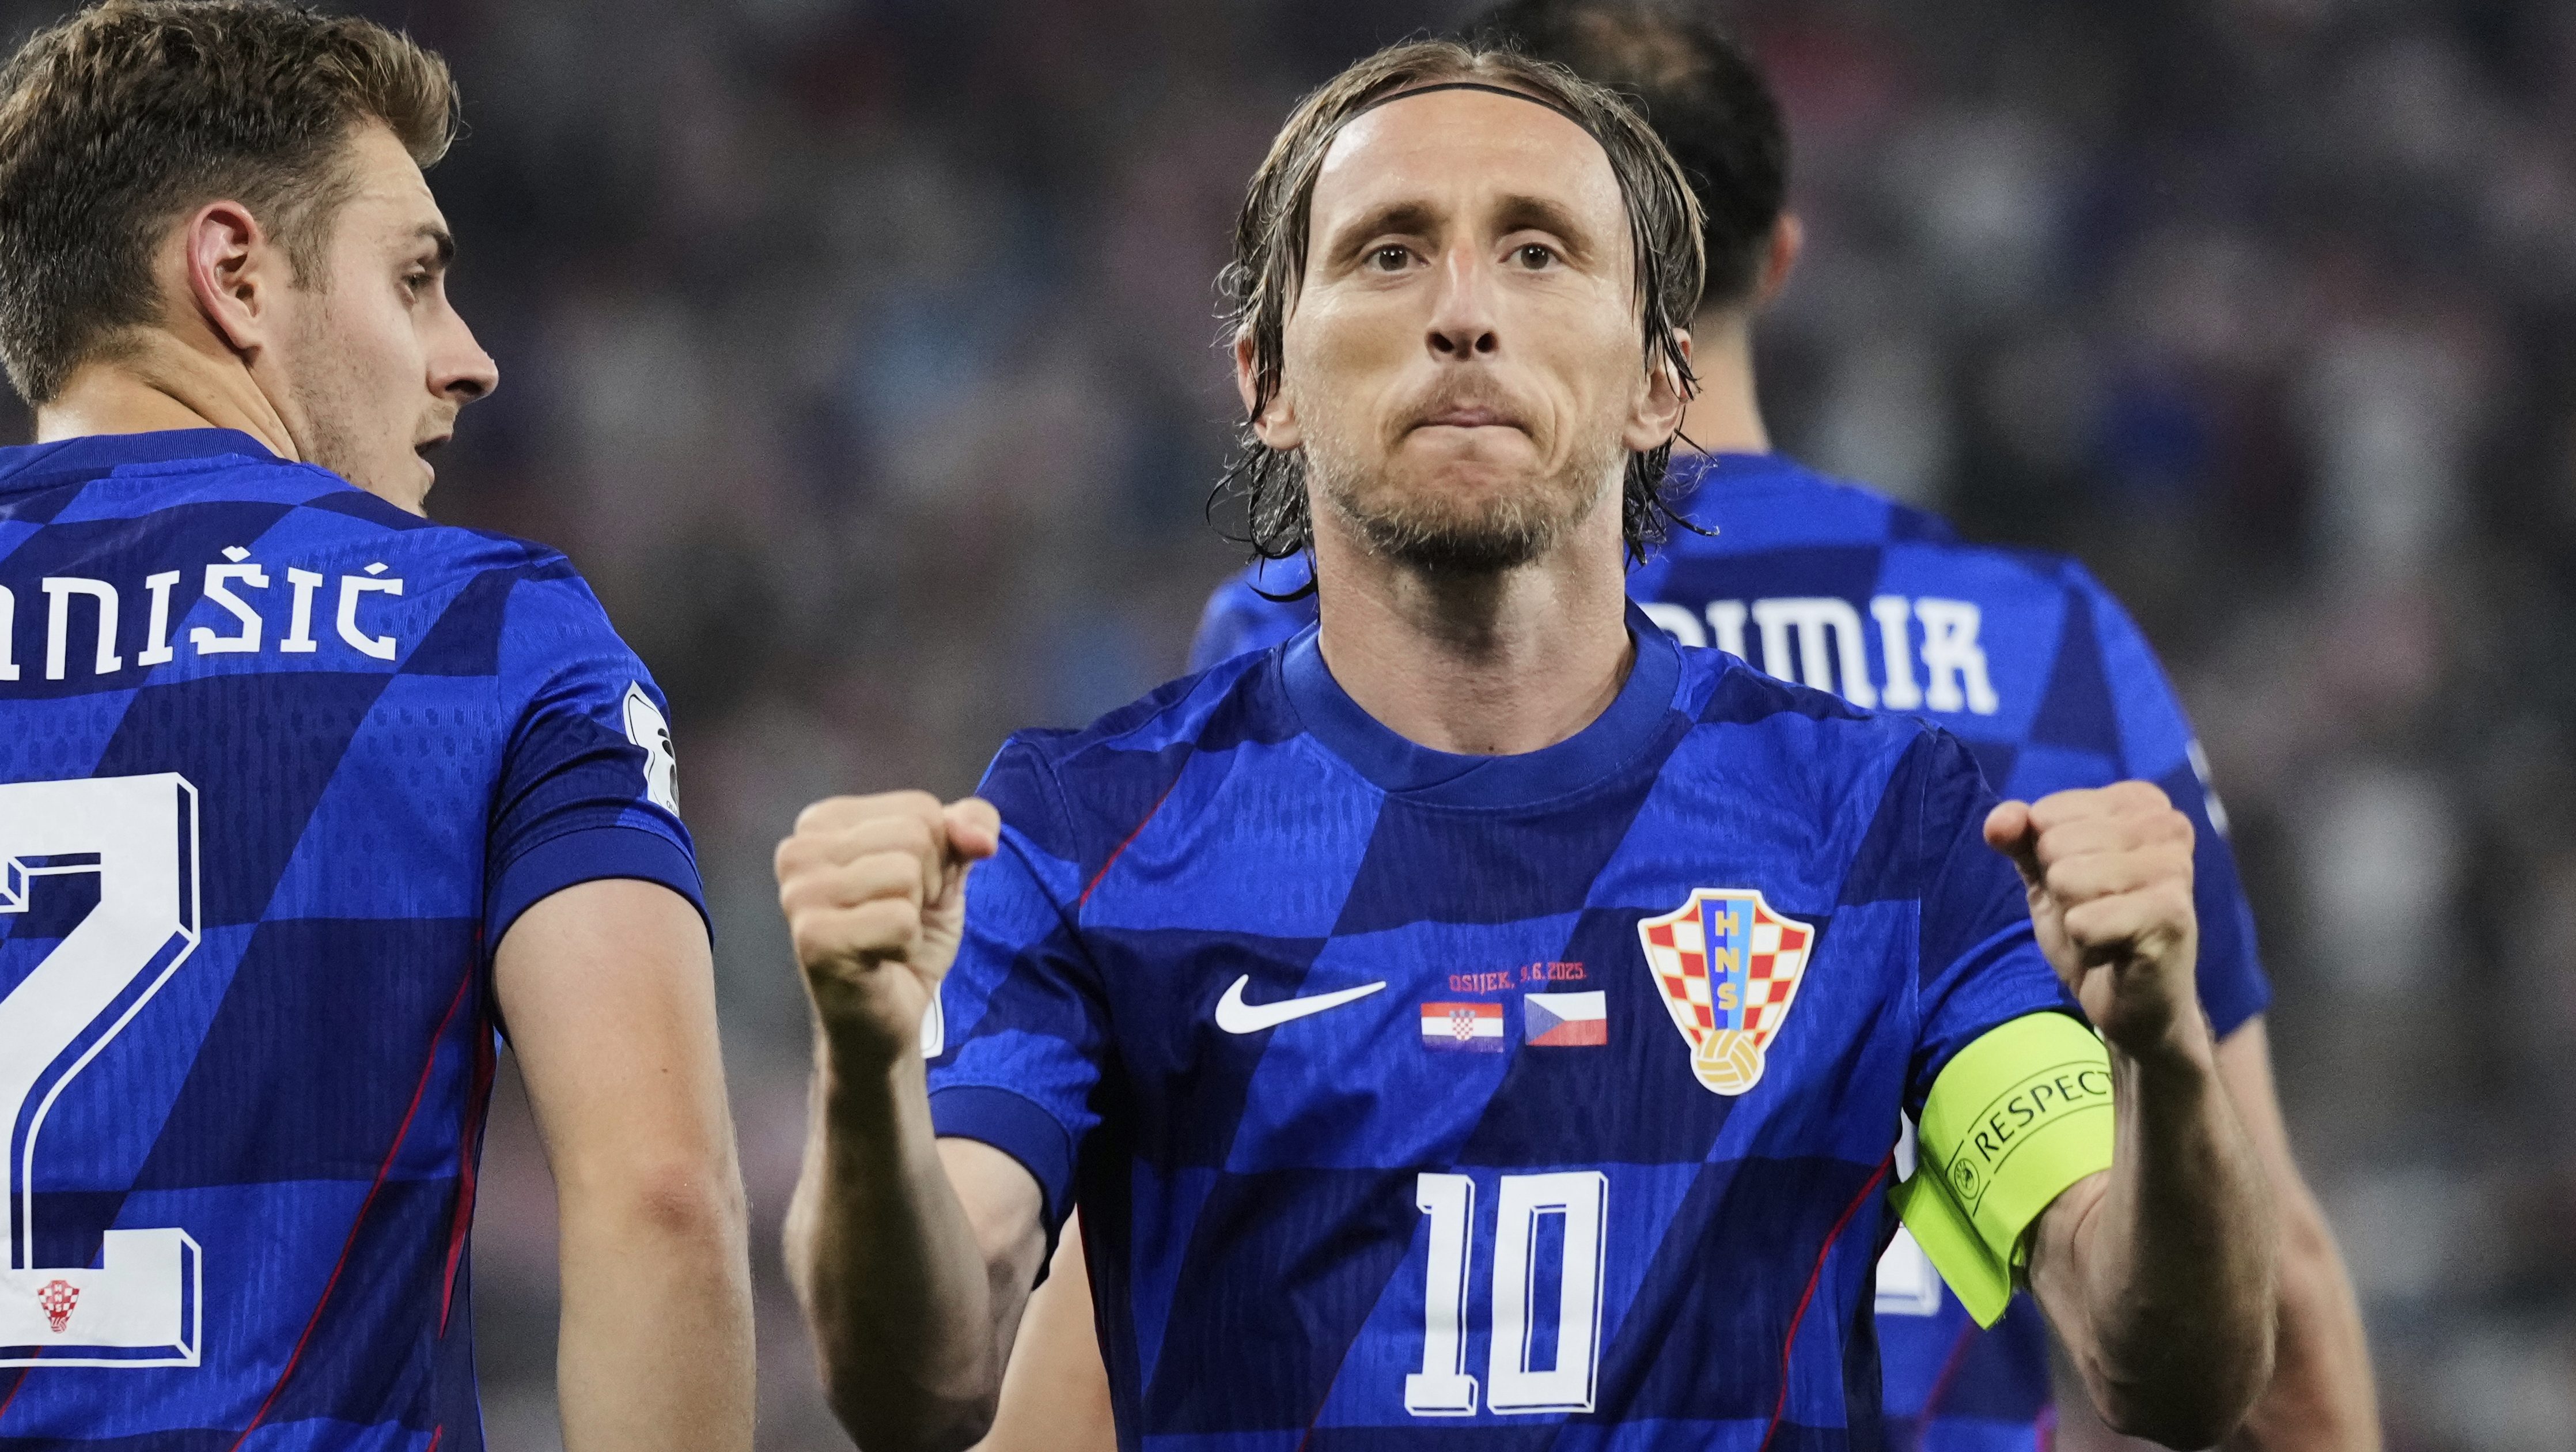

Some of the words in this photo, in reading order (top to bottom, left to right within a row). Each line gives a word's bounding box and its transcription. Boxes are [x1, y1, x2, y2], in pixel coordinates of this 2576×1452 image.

[0, 546, 403, 680] NIŠIĆ
[1449, 971, 1516, 996] OSIJEK,
[1715, 910, 1739, 1010] HNS
[0, 772, 202, 1367] 2
[1404, 1171, 1608, 1417] 10
